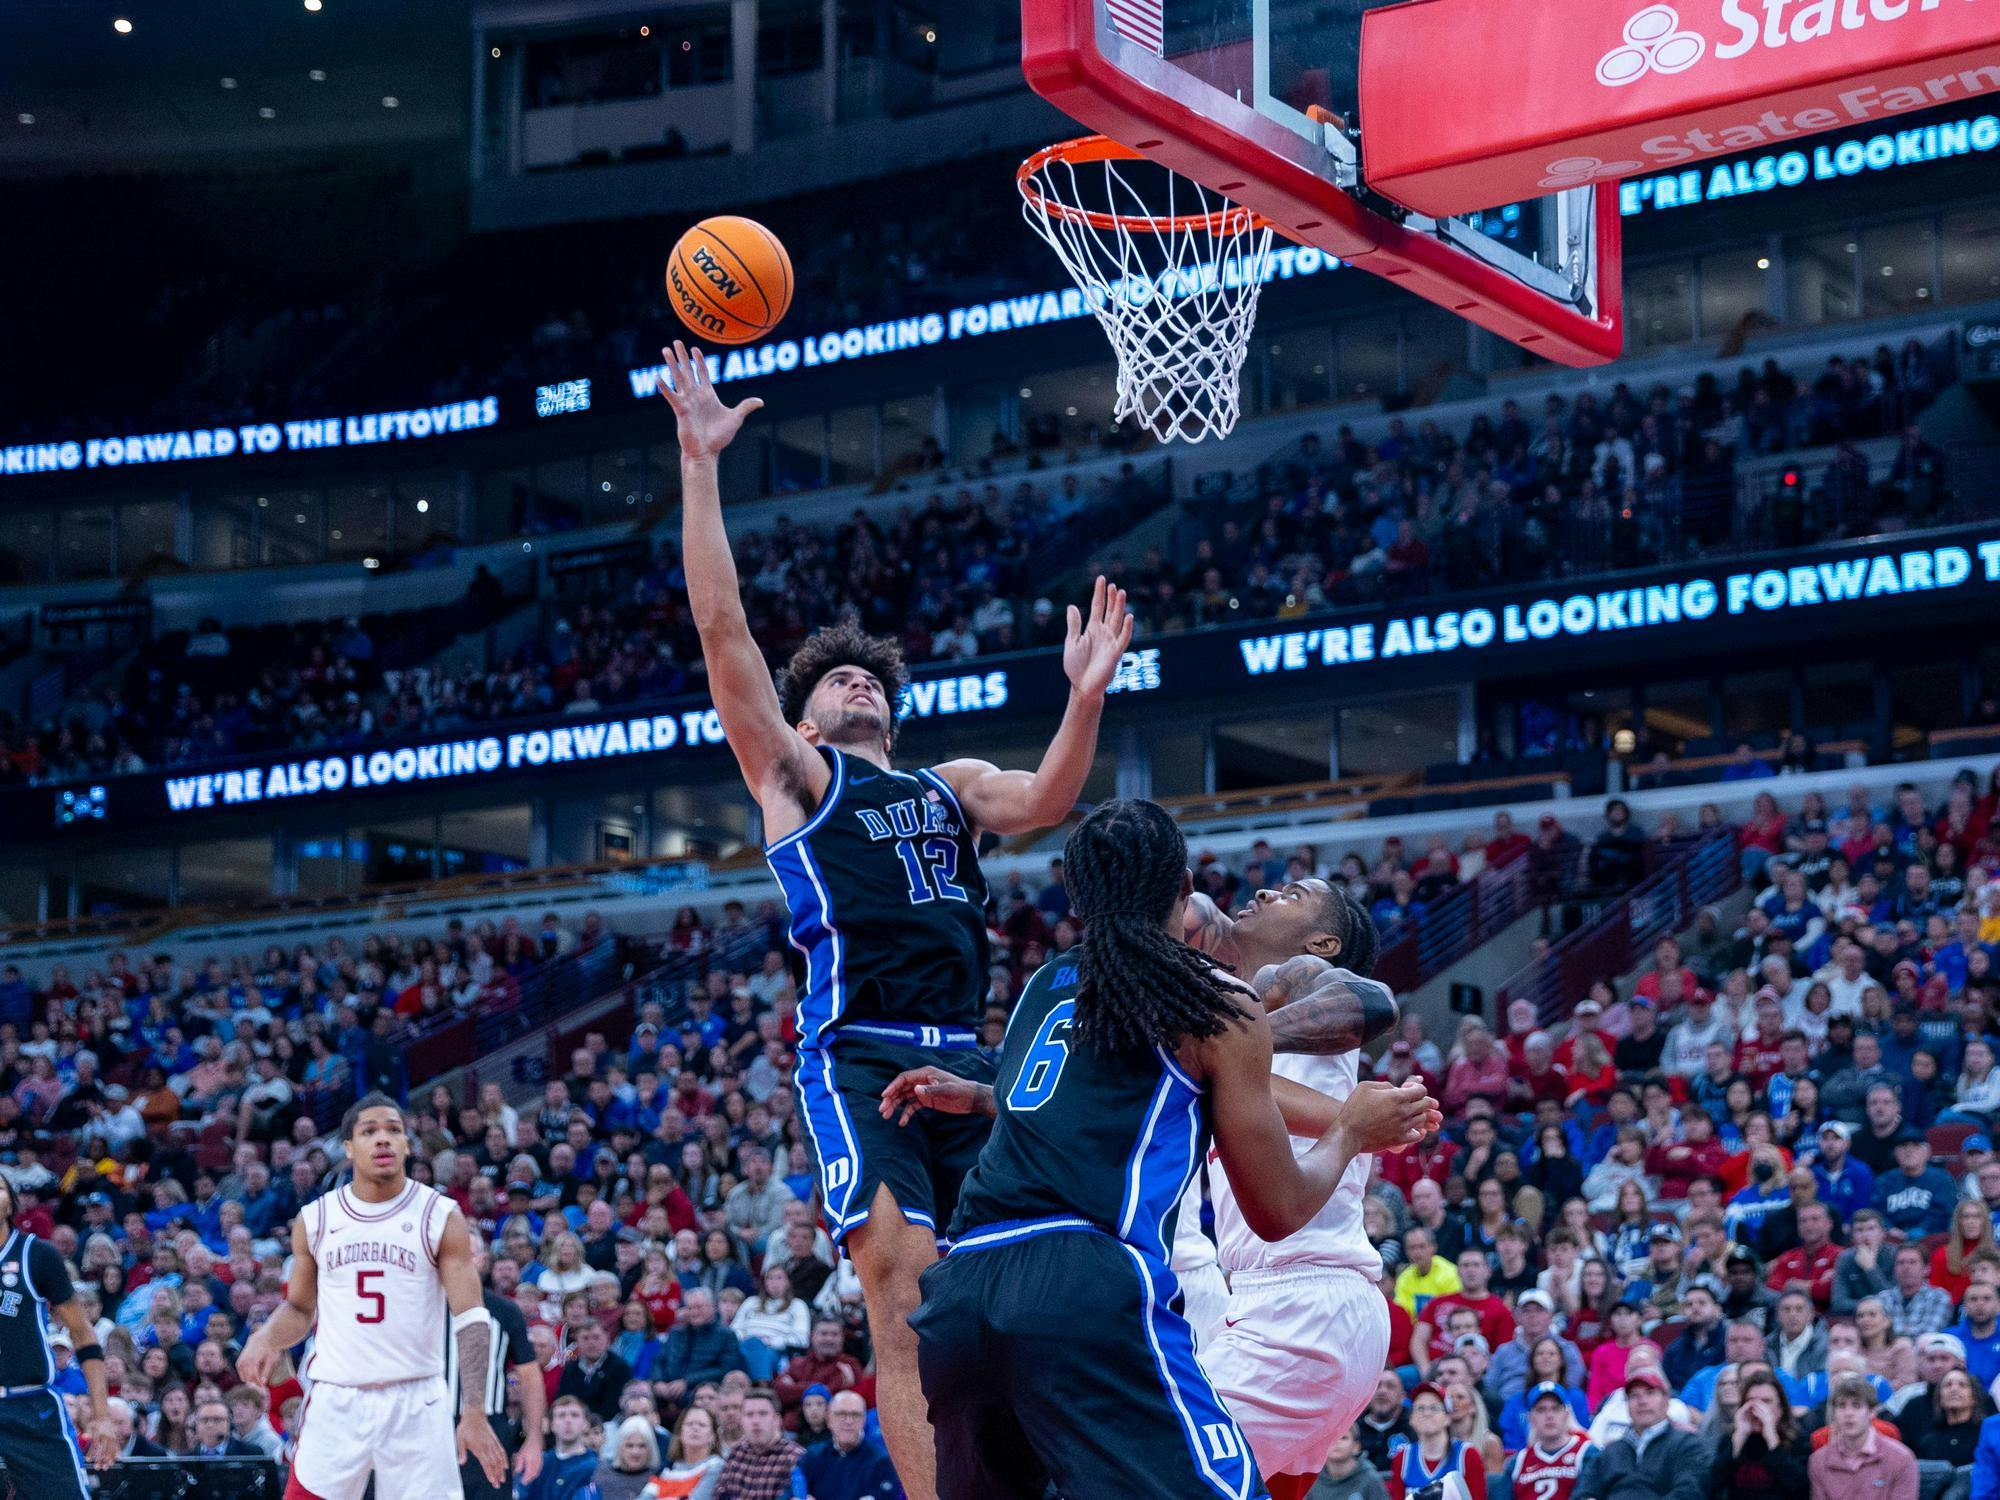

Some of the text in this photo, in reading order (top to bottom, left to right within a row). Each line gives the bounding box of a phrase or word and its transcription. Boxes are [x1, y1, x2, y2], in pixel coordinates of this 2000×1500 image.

[1619, 115, 2000, 216] E'RE ALSO LOOKING
[1641, 108, 1840, 164] State
[670, 264, 726, 335] Wilson
[691, 245, 742, 299] NCAA
[722, 341, 799, 382] ALSO
[803, 313, 943, 366] LOOKING
[948, 283, 1107, 340] FORWARD
[0, 396, 499, 475] KING FORWARD TO THE LEFTOVERS
[1239, 624, 1376, 675] WE'RE
[1381, 608, 1496, 658] ALSO
[1503, 579, 1718, 643] LOOKING
[1726, 546, 1972, 614] FORWARD
[165, 768, 262, 811] WE'RE
[265, 757, 348, 799] ALSO
[351, 737, 501, 788] LOOKING
[507, 715, 678, 768] FORWARD
[681, 708, 726, 745] TO
[895, 836, 968, 904] 12
[1006, 998, 1083, 1111] 6
[326, 1241, 418, 1273] RAZORBACKS
[355, 1270, 386, 1324] 5
